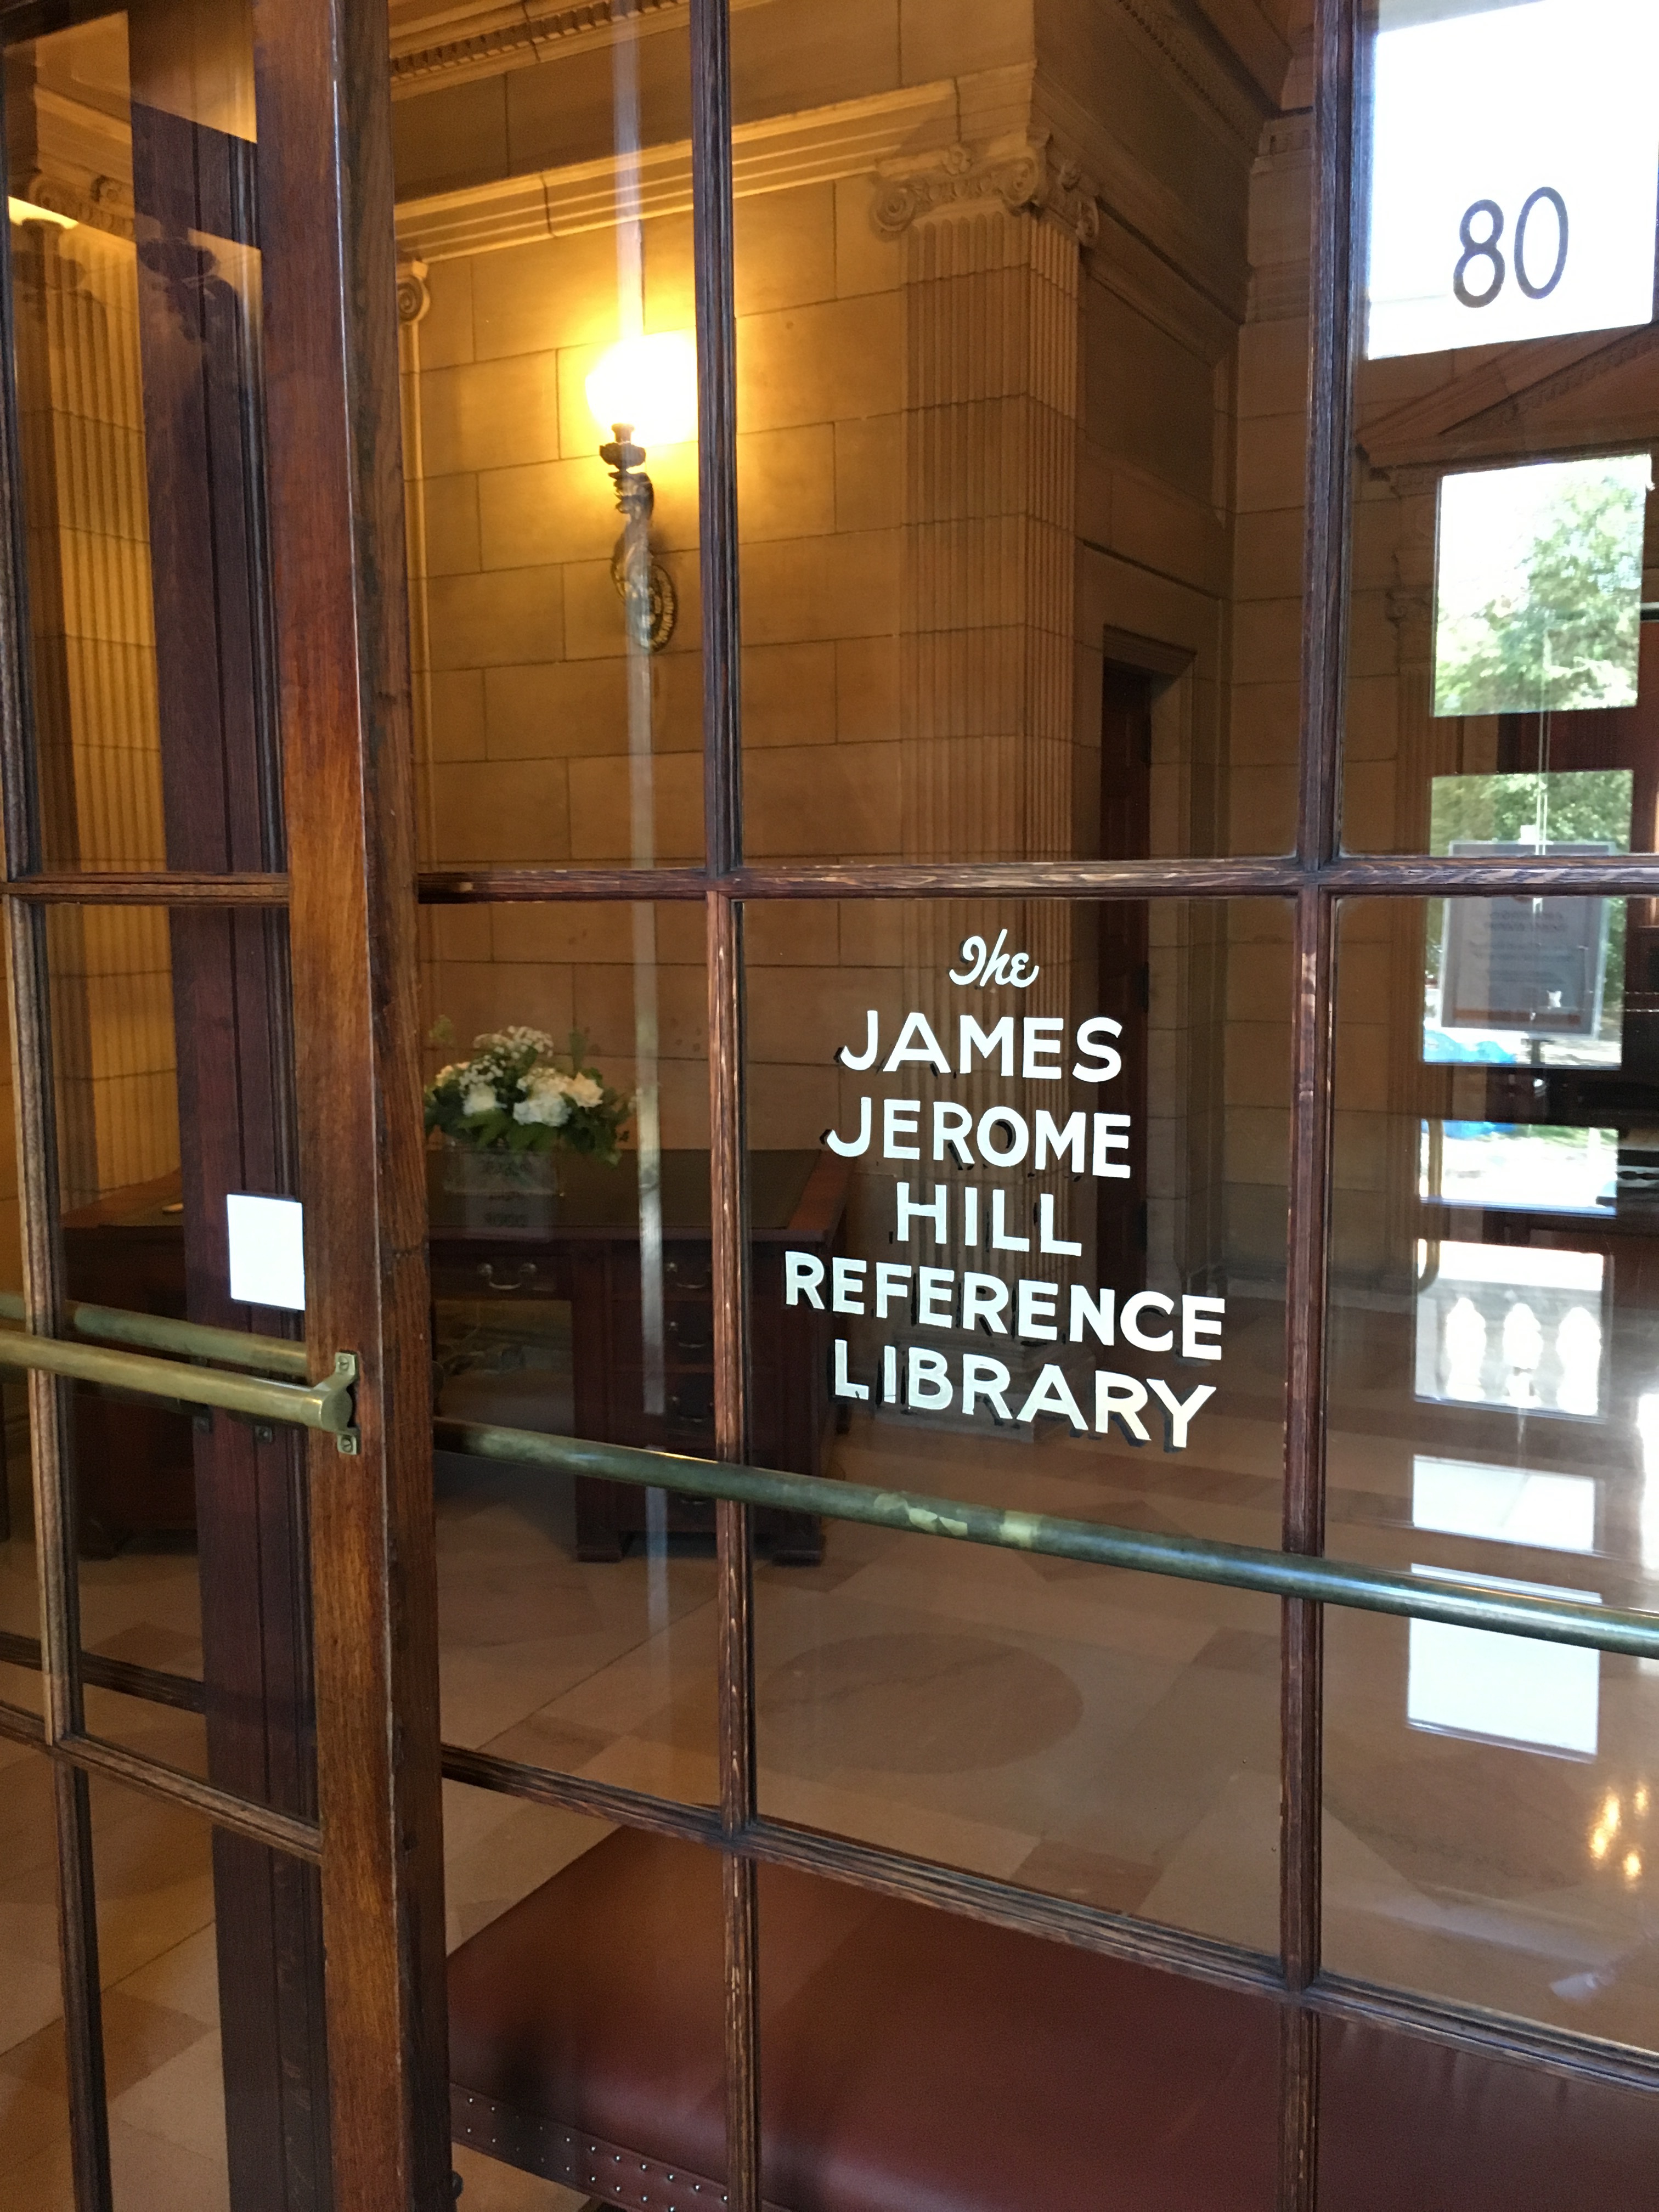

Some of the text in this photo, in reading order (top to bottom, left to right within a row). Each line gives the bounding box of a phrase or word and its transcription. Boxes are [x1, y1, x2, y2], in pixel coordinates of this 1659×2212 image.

[1453, 187, 1569, 309] 80
[949, 929, 1040, 988] The
[840, 1009, 1122, 1083] JAMES
[826, 1097, 1131, 1179] JEROME
[896, 1182, 1082, 1257] HILL
[785, 1251, 1226, 1361] REFERENCE
[834, 1339, 1217, 1448] LIBRARY
